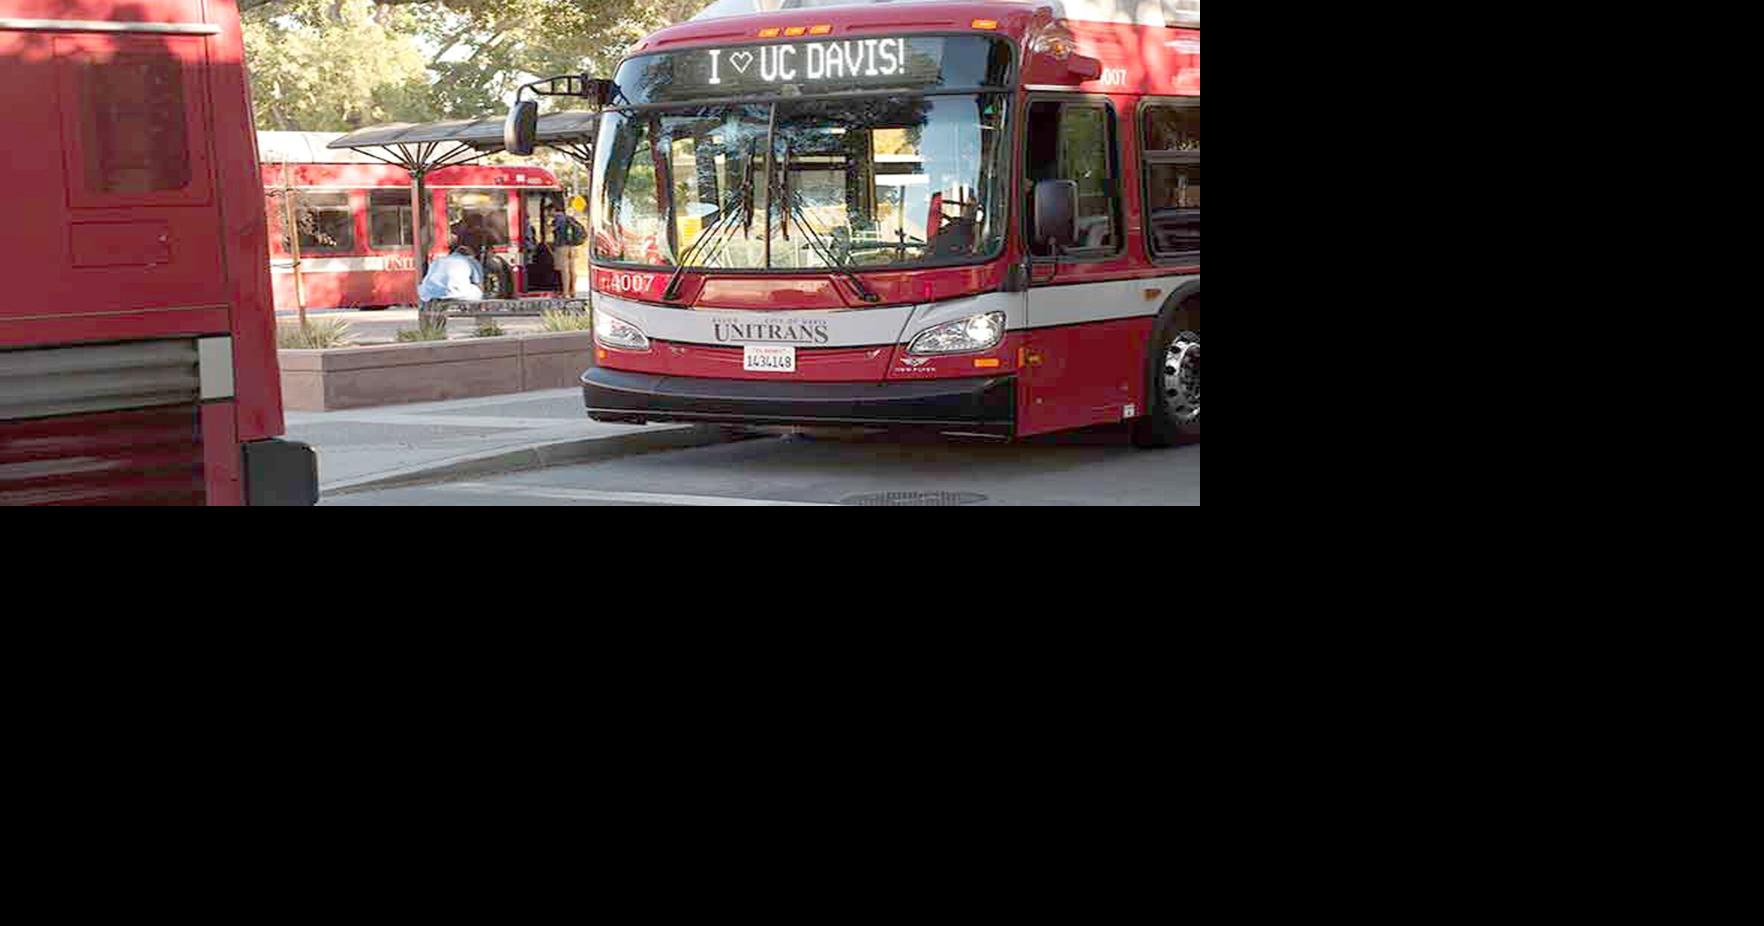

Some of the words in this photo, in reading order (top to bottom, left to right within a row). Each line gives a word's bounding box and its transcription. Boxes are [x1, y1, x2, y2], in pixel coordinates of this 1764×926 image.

[708, 49, 721, 84] I
[760, 44, 796, 81] UC
[806, 38, 905, 80] DAVIS!
[610, 273, 655, 292] 4007
[714, 322, 829, 344] UNITRANS
[747, 354, 791, 369] 1434148
